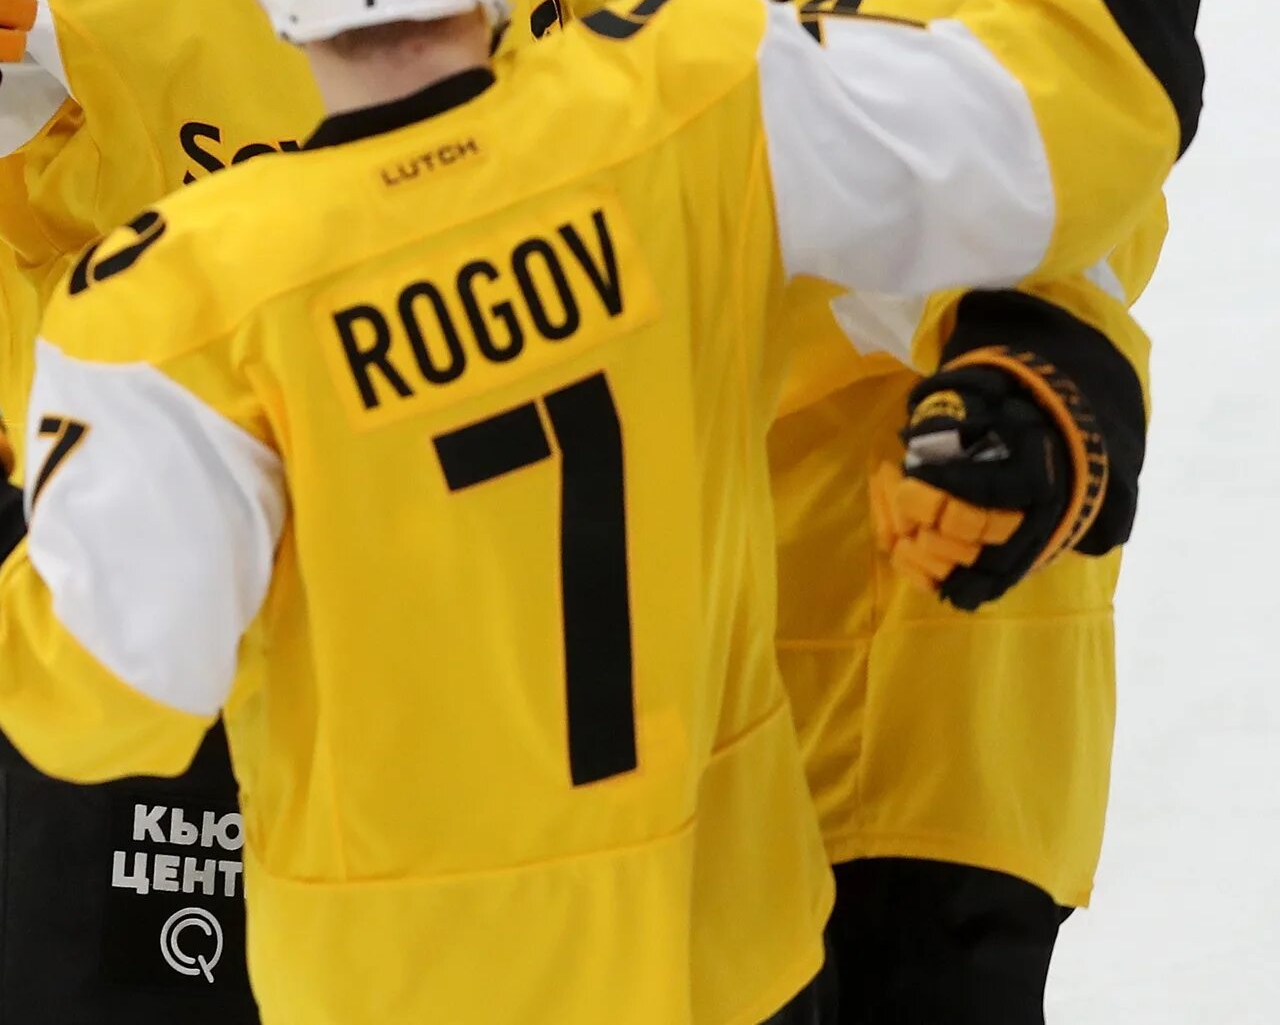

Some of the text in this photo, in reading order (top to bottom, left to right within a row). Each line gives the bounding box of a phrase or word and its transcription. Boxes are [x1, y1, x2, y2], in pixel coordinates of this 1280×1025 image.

[380, 137, 480, 186] LUTCH
[331, 207, 624, 411] ROGOV
[31, 415, 90, 514] 7
[431, 368, 638, 789] 7
[111, 850, 246, 898] ЦЕНТ
